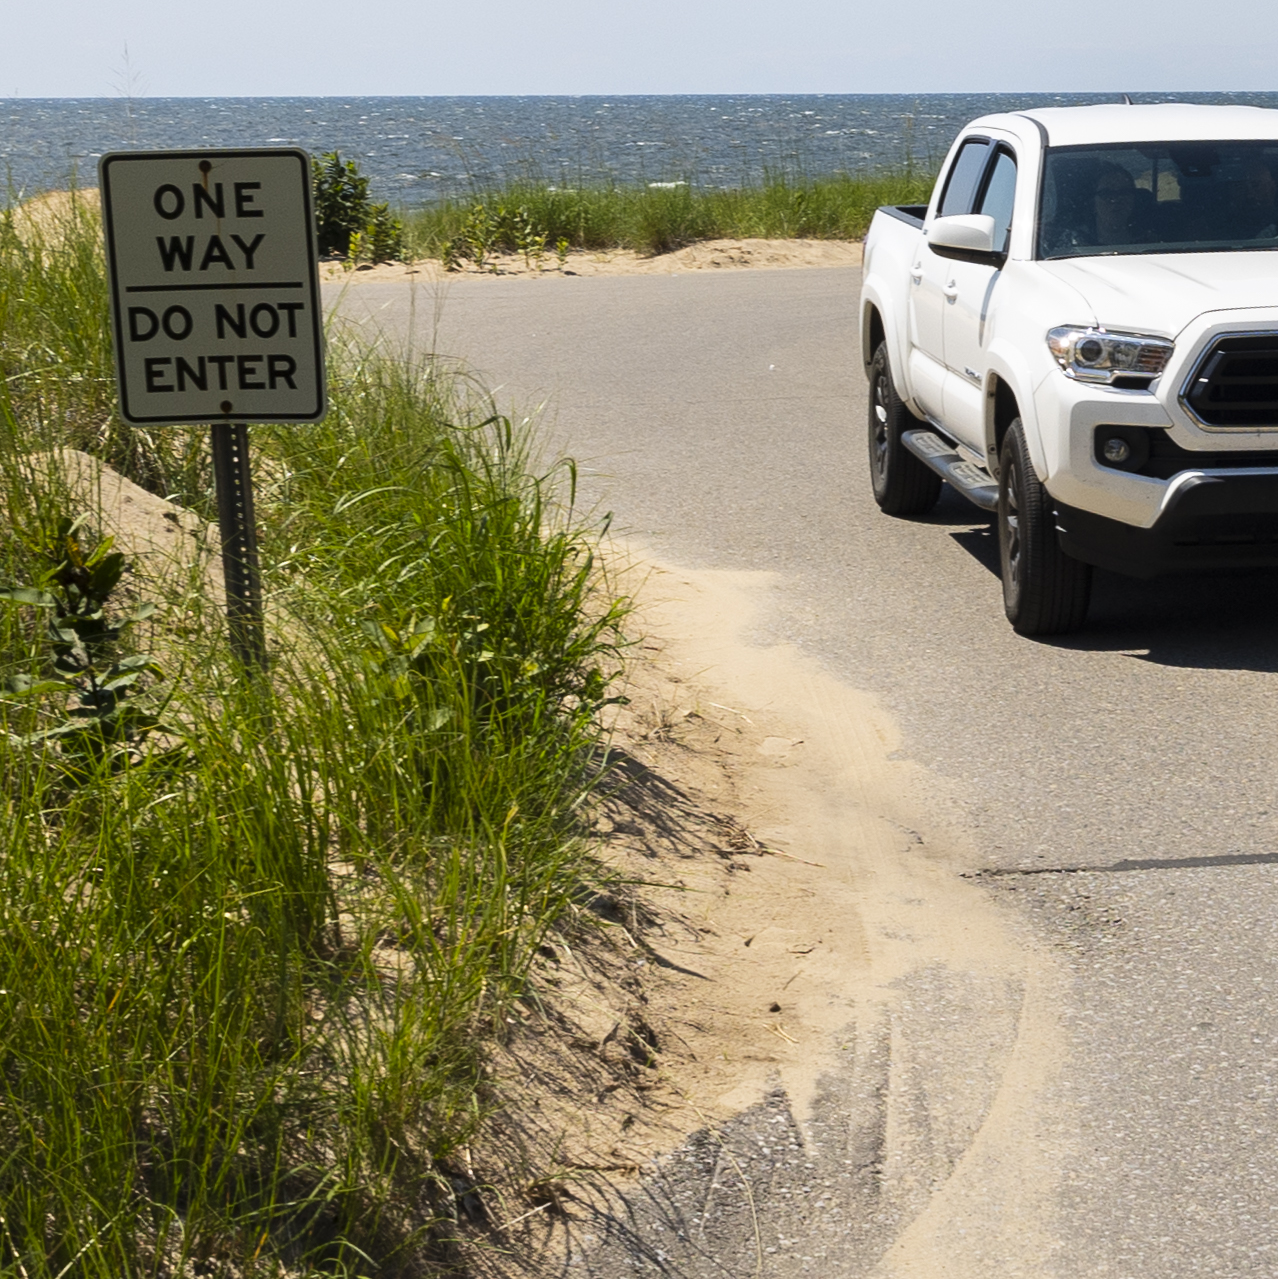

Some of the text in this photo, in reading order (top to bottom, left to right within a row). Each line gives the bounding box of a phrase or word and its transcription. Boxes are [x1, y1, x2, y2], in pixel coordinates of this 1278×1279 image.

[153, 182, 264, 220] ONE
[156, 233, 266, 272] WAY
[127, 302, 304, 342] DO NOT
[144, 354, 298, 393] ENTER
